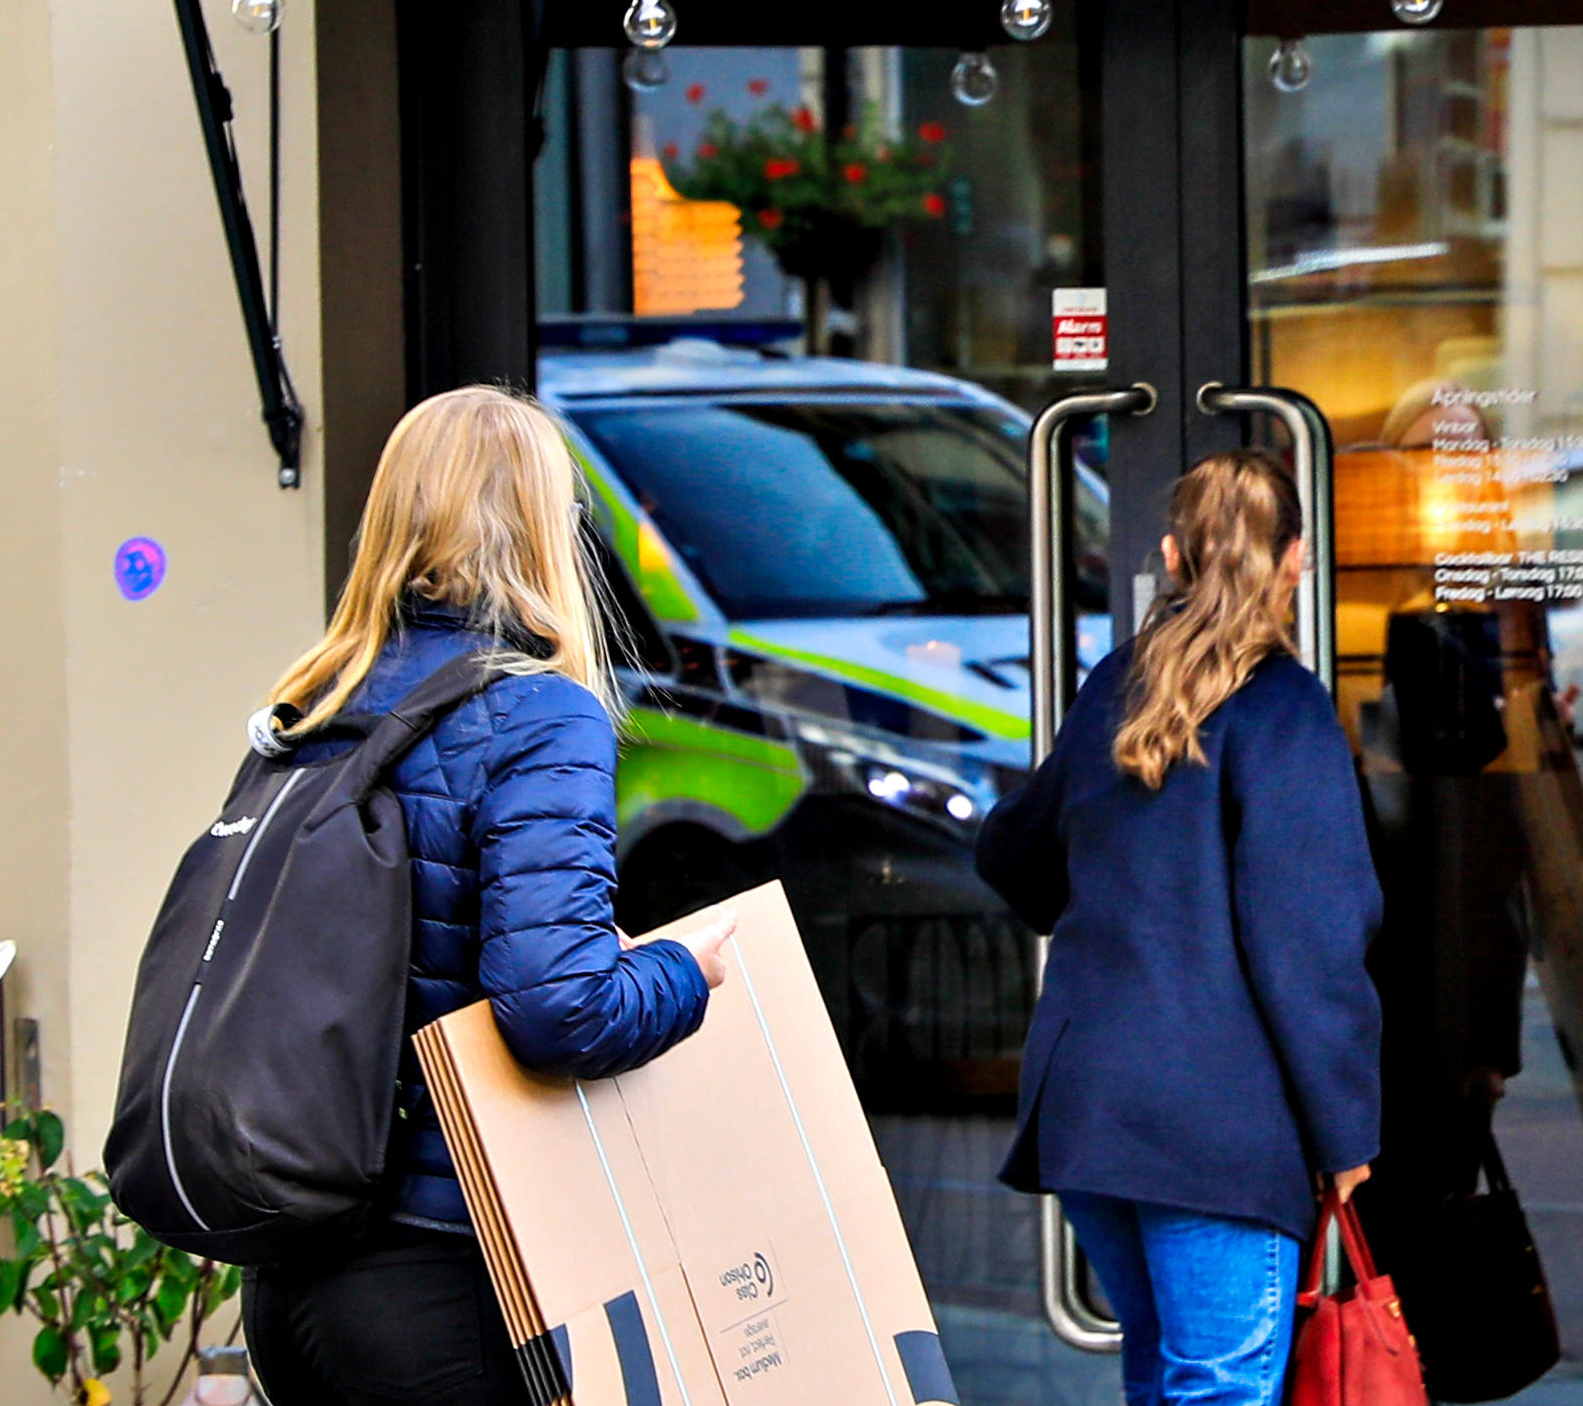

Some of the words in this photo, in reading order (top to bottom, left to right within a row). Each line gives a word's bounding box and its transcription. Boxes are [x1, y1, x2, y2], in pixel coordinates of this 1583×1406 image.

[719, 1263, 752, 1287] Ohlson
[736, 1282, 758, 1301] Clas
[749, 1351, 782, 1373] Medium
